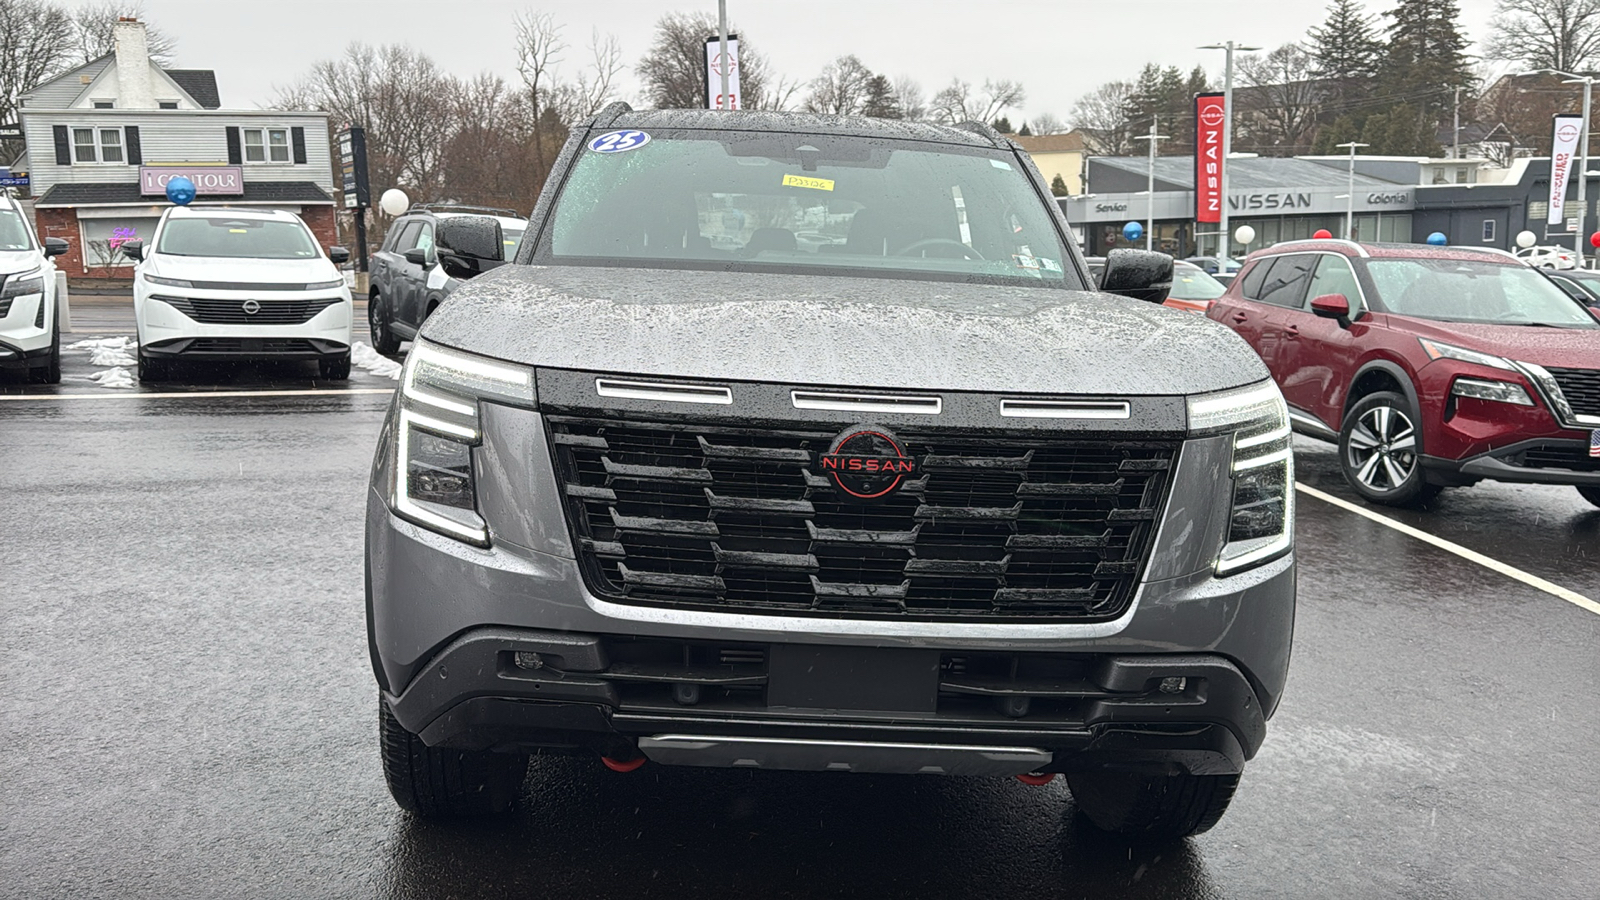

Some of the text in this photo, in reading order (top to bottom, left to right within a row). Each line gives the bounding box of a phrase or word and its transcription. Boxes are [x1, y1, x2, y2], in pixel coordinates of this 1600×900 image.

[596, 132, 641, 151] 25
[1206, 131, 1219, 210] NISSAN
[1228, 193, 1311, 209] NISSAN
[1367, 192, 1409, 204] Colonial
[1095, 202, 1127, 212] Service
[823, 457, 912, 472] NISSAN
